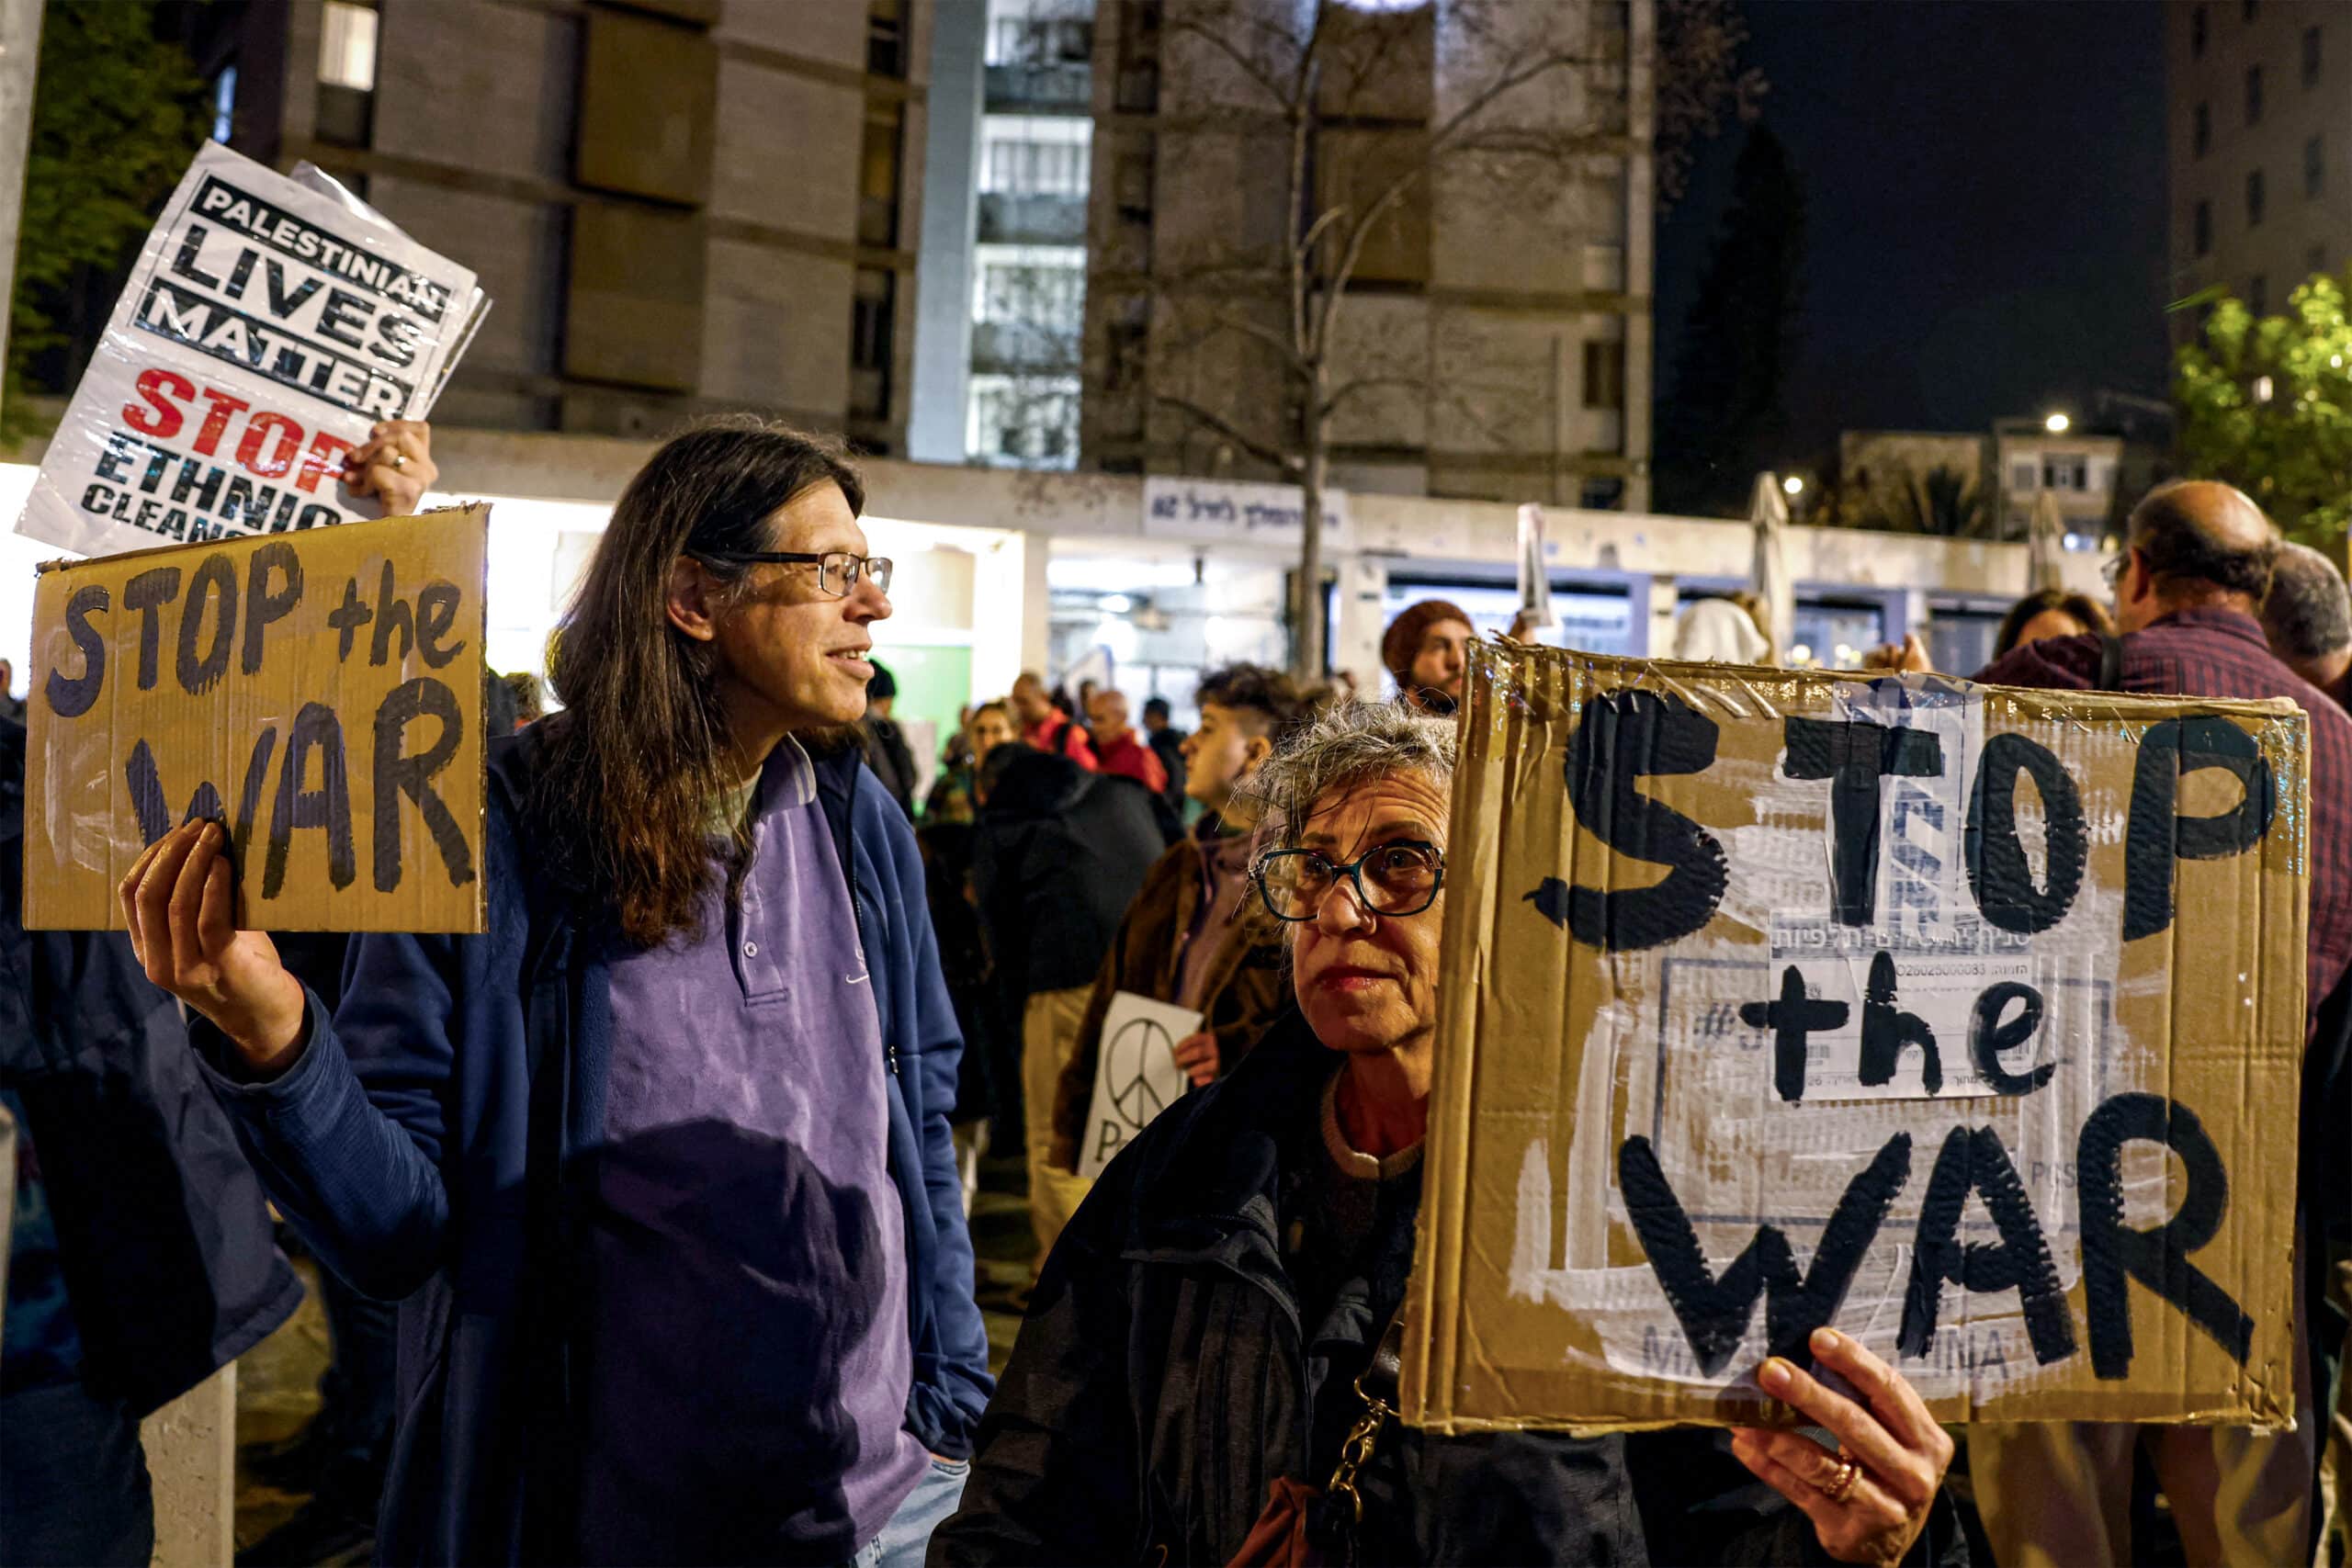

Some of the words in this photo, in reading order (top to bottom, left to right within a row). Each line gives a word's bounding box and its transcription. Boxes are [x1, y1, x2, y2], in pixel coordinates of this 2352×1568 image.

[171, 224, 421, 367] LIVES
[202, 186, 443, 313] PALESTINIAN
[146, 287, 405, 420] MATTER
[121, 368, 357, 493] STOP
[45, 540, 304, 716] STOP
[328, 558, 466, 669] the
[126, 677, 476, 899] WAR
[1522, 688, 2276, 952] STOP
[1738, 950, 2056, 1101] the
[1618, 1091, 2256, 1380] WAR
